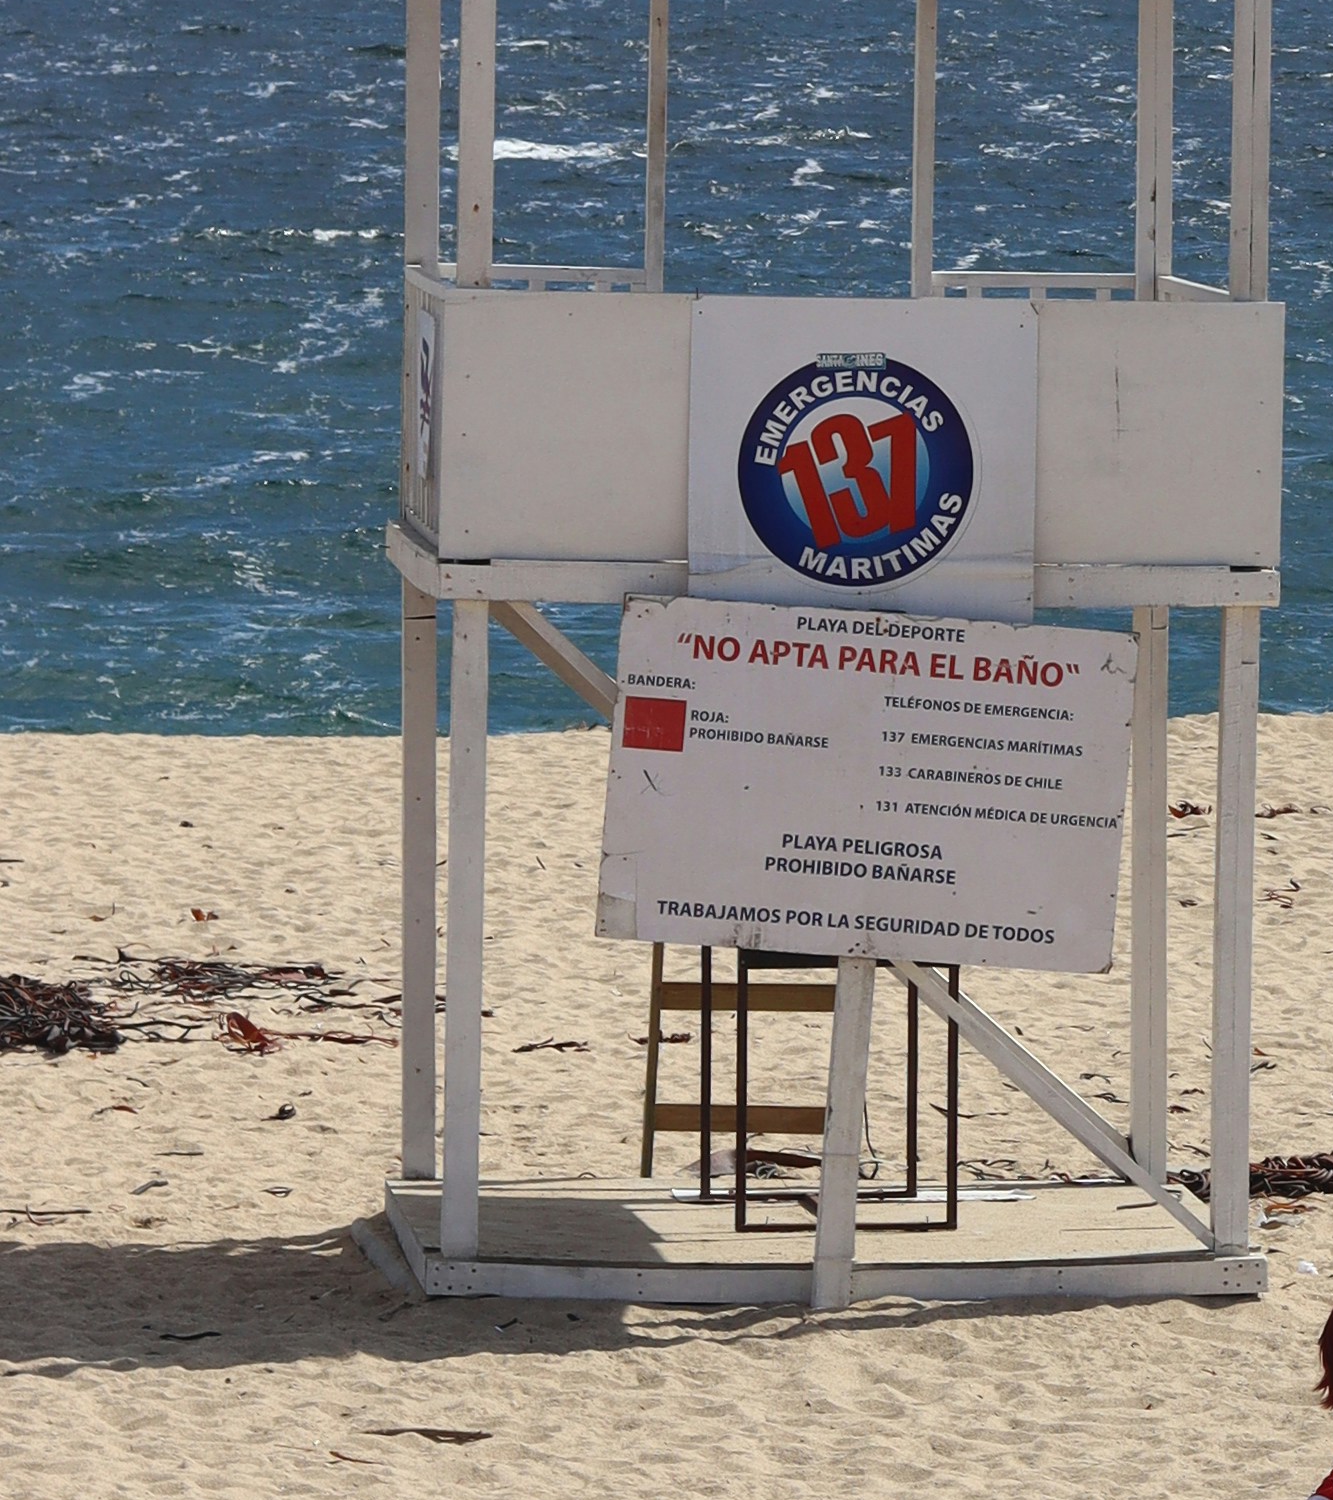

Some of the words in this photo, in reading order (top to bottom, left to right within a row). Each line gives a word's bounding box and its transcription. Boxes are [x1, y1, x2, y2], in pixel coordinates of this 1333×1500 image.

[754, 370, 944, 467] EMERGENCIAS
[777, 411, 917, 550] 137
[798, 492, 963, 580] MARITIMAS
[797, 616, 848, 633] PLAYA
[852, 621, 883, 636] DEL
[888, 624, 966, 643] DEPORTE
[748, 639, 829, 670] APTA
[838, 646, 921, 677] PARA
[929, 653, 964, 680] EL
[627, 673, 696, 690] BANDERA:
[690, 709, 729, 724] ROJA:
[884, 696, 960, 713] TELÉFONOS
[963, 702, 981, 714] DE
[984, 704, 1074, 721] EMERGENCIA:
[689, 727, 764, 744] PROHIBIDO
[767, 732, 829, 749] BAÑARSE
[881, 731, 905, 743] 137
[911, 733, 1004, 751] EMERGENCIAS
[1007, 737, 1083, 757] MARÍTIMAS
[878, 766, 902, 778] 133
[908, 767, 1001, 785] CARABINEROS
[1004, 775, 1022, 787] DE
[1025, 777, 1063, 790] CHILE
[875, 801, 898, 813] 131
[904, 802, 971, 818] ATENCIÓN
[974, 806, 1027, 822] MÉDICA
[1030, 812, 1047, 824] DE
[1050, 814, 1118, 829] URGENCIA
[781, 833, 838, 853] PLAYA
[842, 838, 943, 860] PELIGROSA
[764, 856, 868, 879] PROHIBIDO
[872, 862, 956, 885] BAÑARSE
[657, 900, 782, 924] TRABAJAMOS
[785, 910, 823, 928] POR
[827, 912, 850, 929] LA
[854, 914, 960, 938] SEGURIDAD
[964, 923, 988, 940] DE
[993, 925, 1055, 945] TODOS
